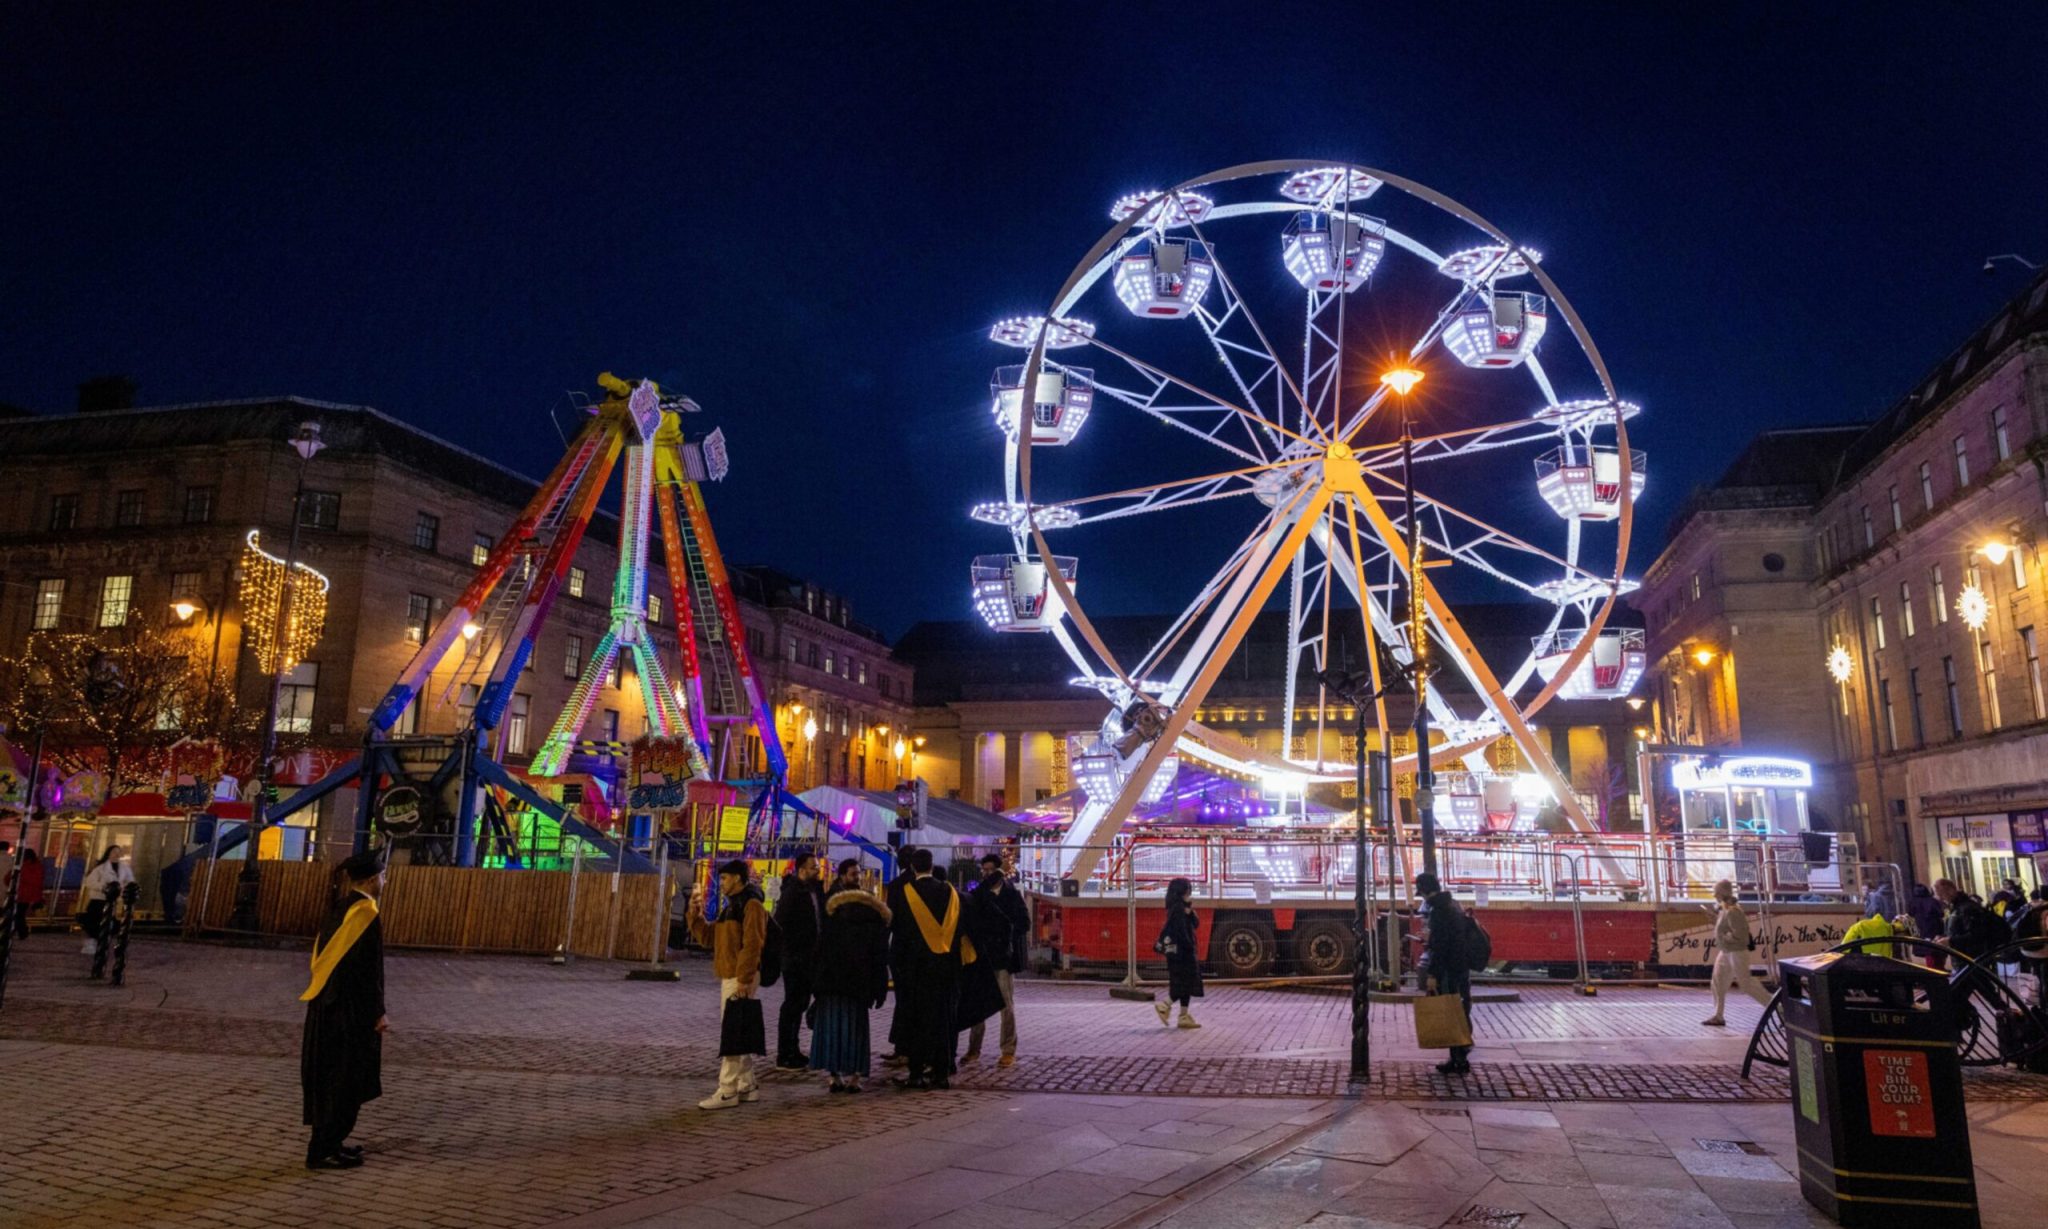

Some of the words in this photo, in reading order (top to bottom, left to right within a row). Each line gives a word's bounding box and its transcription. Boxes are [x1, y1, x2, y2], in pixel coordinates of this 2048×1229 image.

[1665, 932, 1700, 953] Are
[1773, 925, 1795, 954] for
[1793, 924, 1816, 942] the
[1870, 1012, 1907, 1025] Liter
[1878, 1056, 1913, 1066] TIME
[1886, 1065, 1906, 1075] TO
[1885, 1075, 1910, 1084] BIN
[1878, 1084, 1919, 1094] YOUR
[1882, 1094, 1922, 1104] GUM?
